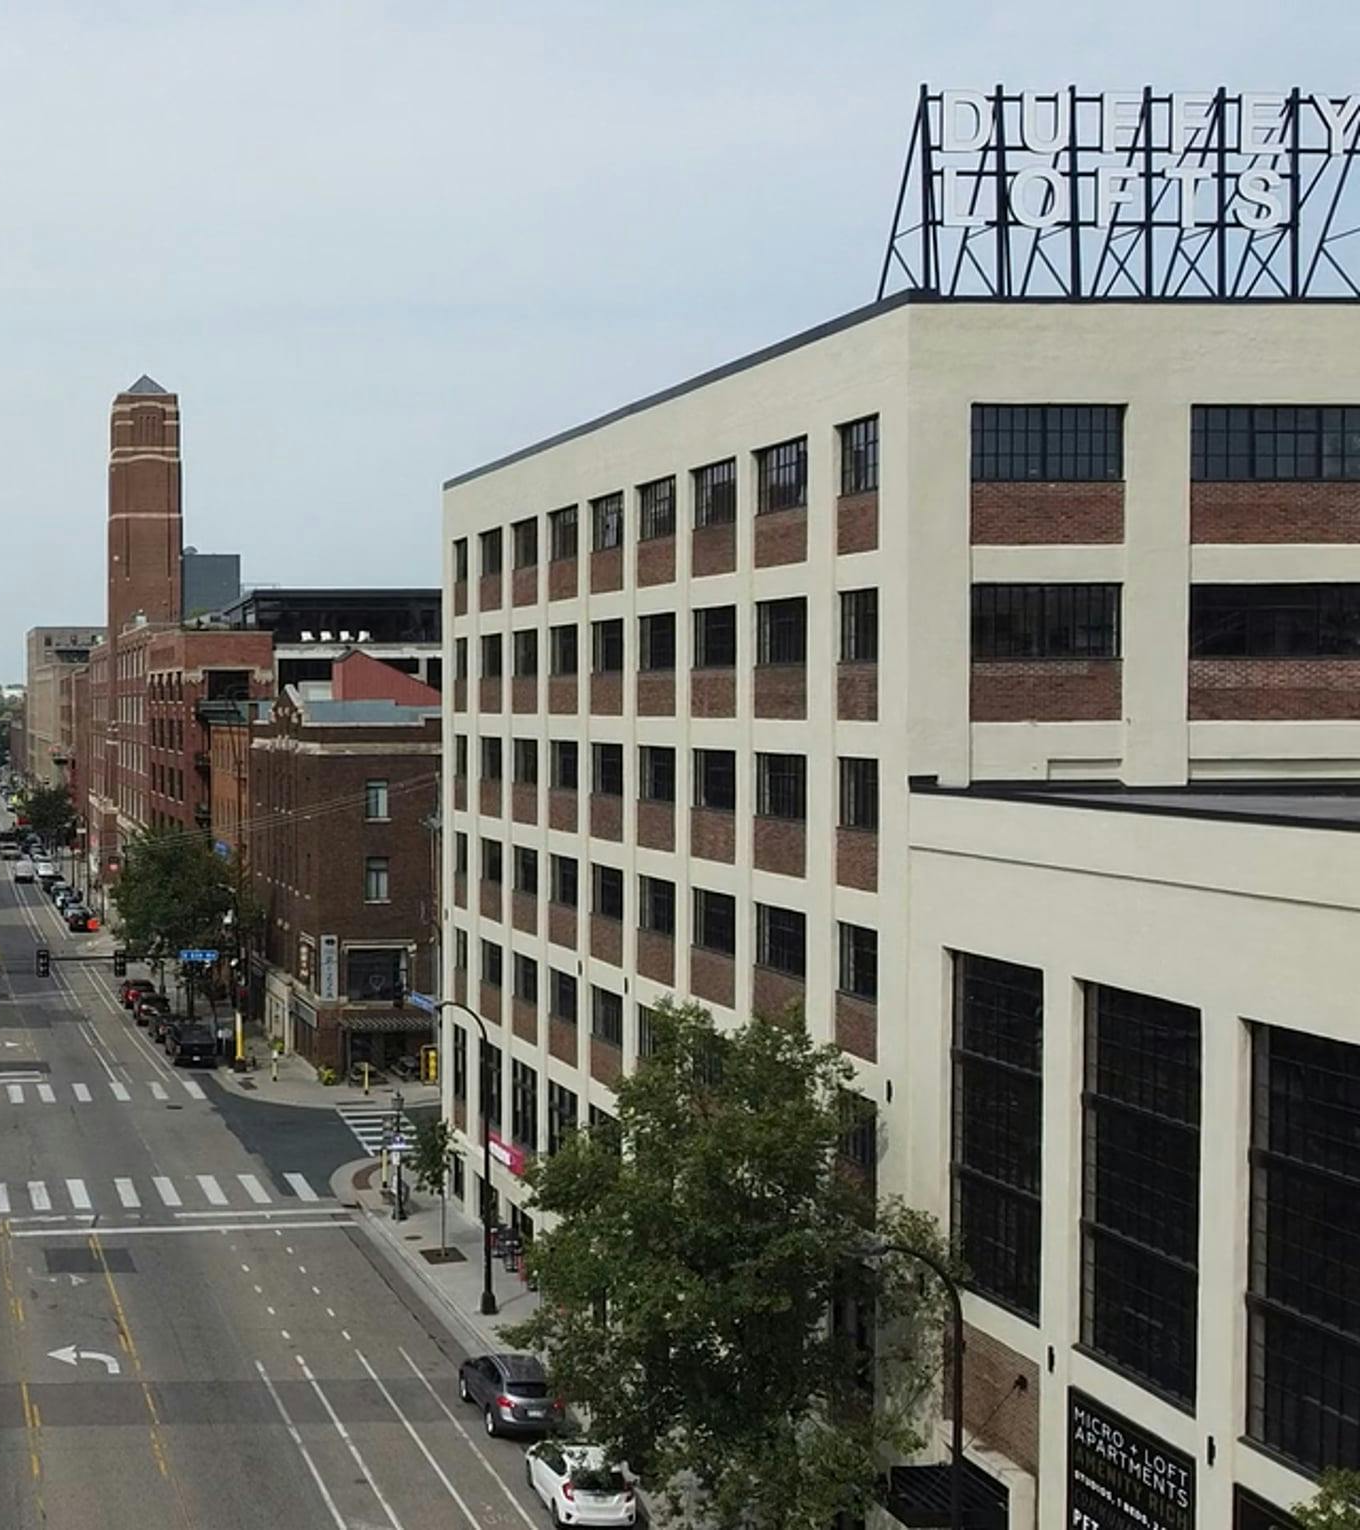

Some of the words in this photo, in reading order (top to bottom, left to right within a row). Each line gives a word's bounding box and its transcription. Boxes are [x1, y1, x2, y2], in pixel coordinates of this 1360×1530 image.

[941, 89, 1360, 156] DUFFEY
[941, 165, 1293, 230] LOFTS
[1074, 1406, 1124, 1449] MICRO
[1144, 1449, 1188, 1488] LOFT
[1074, 1426, 1189, 1508] APARTMENTS
[1074, 1445, 1142, 1501] AMENITY
[1149, 1493, 1187, 1530] RICH
